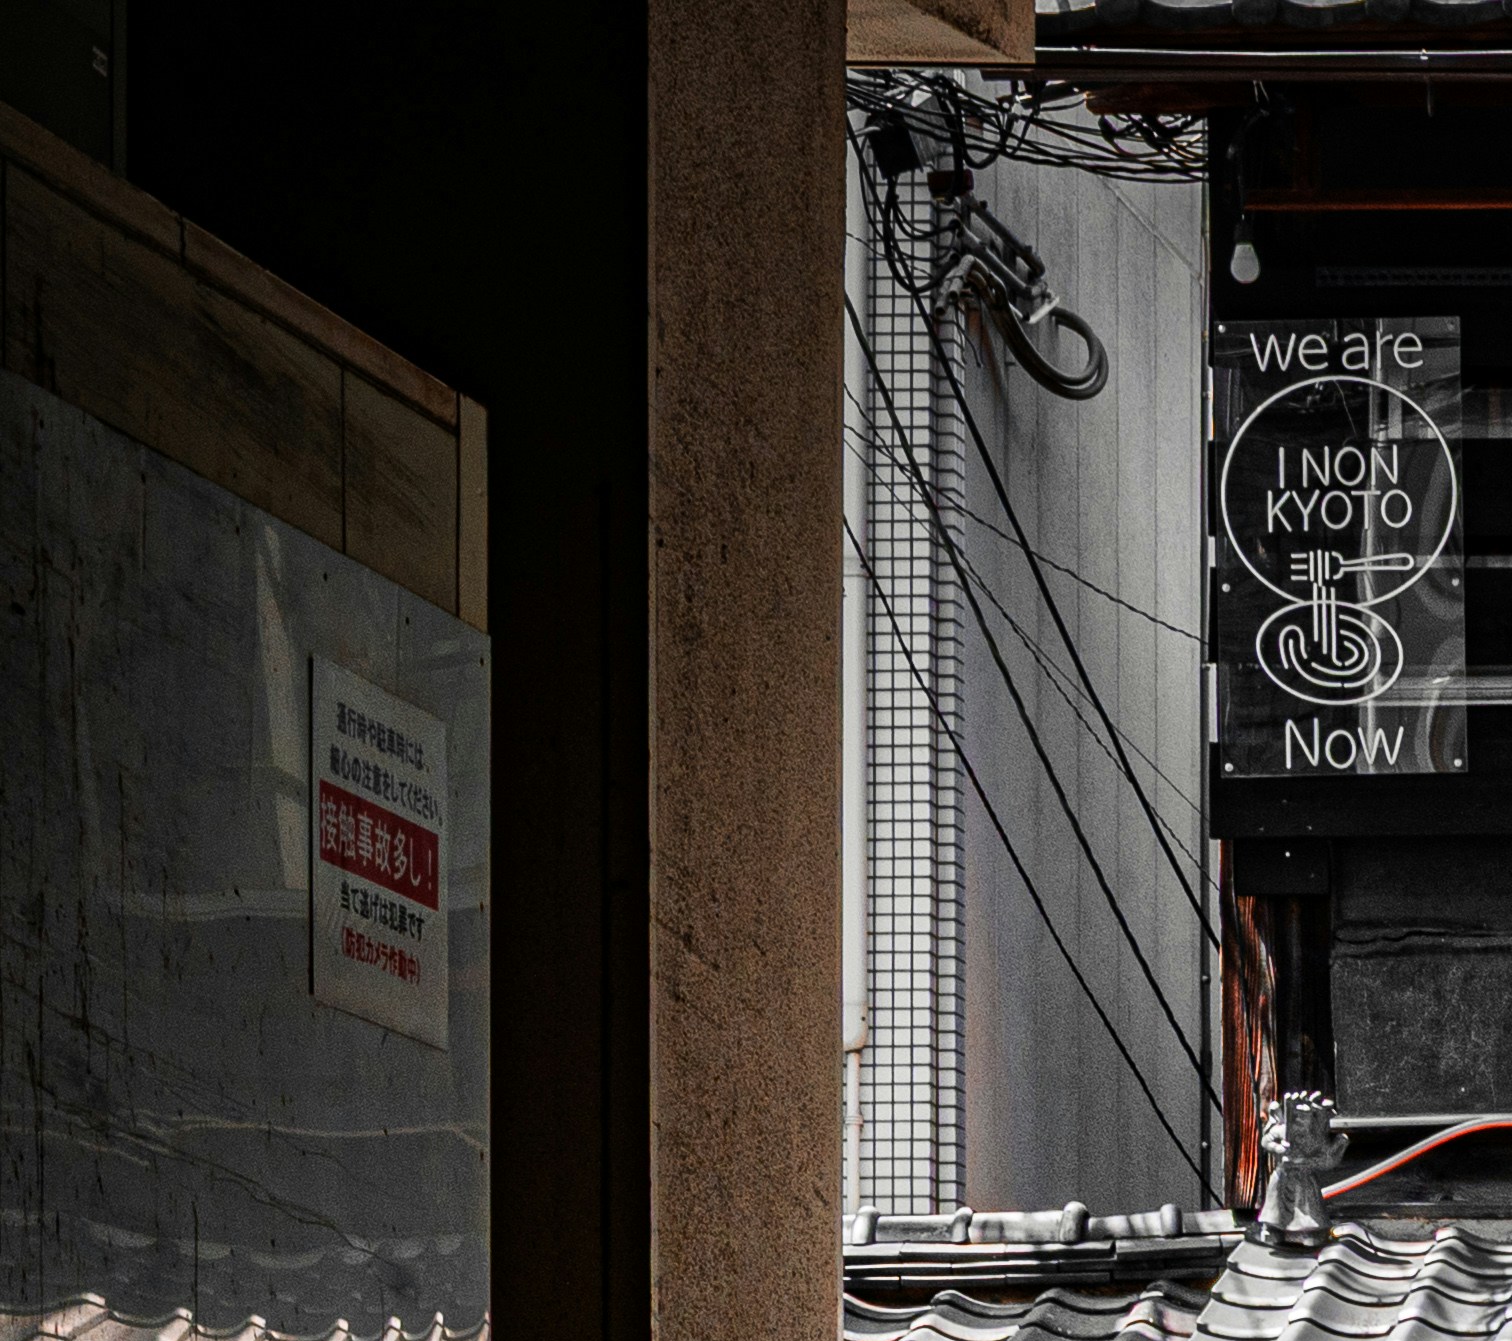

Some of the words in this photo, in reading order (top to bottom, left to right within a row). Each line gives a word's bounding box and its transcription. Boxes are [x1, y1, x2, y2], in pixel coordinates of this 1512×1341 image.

[1251, 333, 1328, 373] we
[1342, 329, 1424, 369] are
[1278, 448, 1287, 487] I
[1301, 446, 1400, 487] NON
[1267, 492, 1413, 533] KYOTO
[1285, 719, 1403, 770] Now
